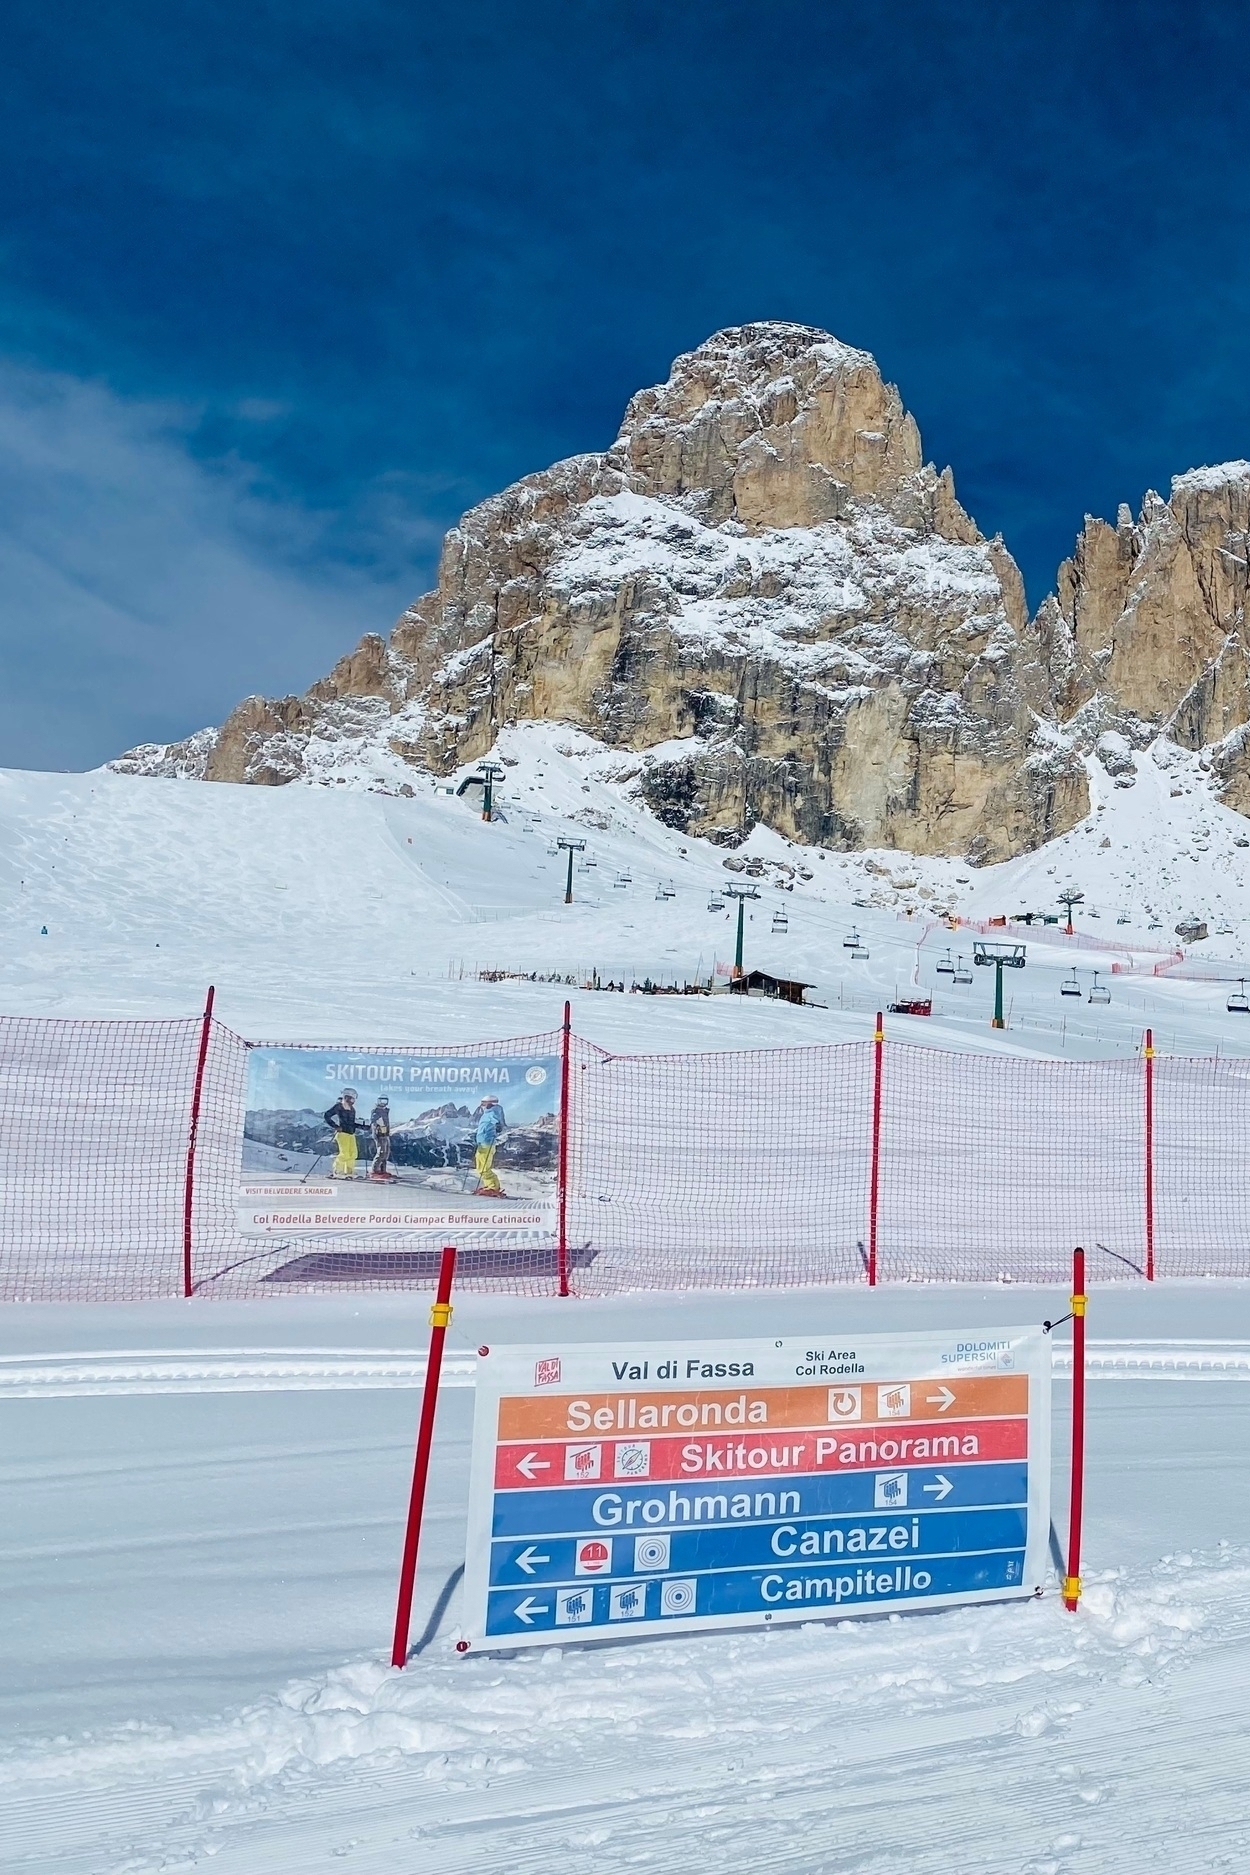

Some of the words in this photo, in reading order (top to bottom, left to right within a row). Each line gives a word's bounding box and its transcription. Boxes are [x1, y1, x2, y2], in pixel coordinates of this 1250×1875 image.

[325, 1063, 404, 1082] SKITOUR
[410, 1066, 510, 1084] PANORAMA
[245, 1187, 263, 1195] VISIT
[264, 1187, 301, 1195] BELVEDERE
[304, 1187, 333, 1195] SKIAREA
[253, 1214, 269, 1224] Col
[272, 1214, 312, 1224] Rodella
[315, 1214, 366, 1224] Belvedere
[369, 1214, 401, 1224] Pordoi
[404, 1215, 445, 1226] Ciampac
[448, 1214, 490, 1224] Buffaure
[492, 1214, 541, 1224] Catinaccio
[957, 1340, 1011, 1353] DOLOMITI
[805, 1351, 825, 1361] Ski
[828, 1350, 856, 1360] Area
[941, 1351, 996, 1364] SUPERSKI
[611, 1361, 648, 1380] Val
[657, 1360, 678, 1379] di
[686, 1360, 755, 1378] Fassa
[796, 1365, 816, 1376] Col
[820, 1363, 865, 1375] Rodella
[566, 1395, 768, 1432] Sellaronda
[680, 1442, 805, 1473] Skitour
[816, 1434, 979, 1465] Panorama
[592, 1490, 801, 1526] Grohmann
[770, 1517, 920, 1557] Canazei
[587, 1545, 603, 1559] 11
[760, 1565, 932, 1603] Campitello
